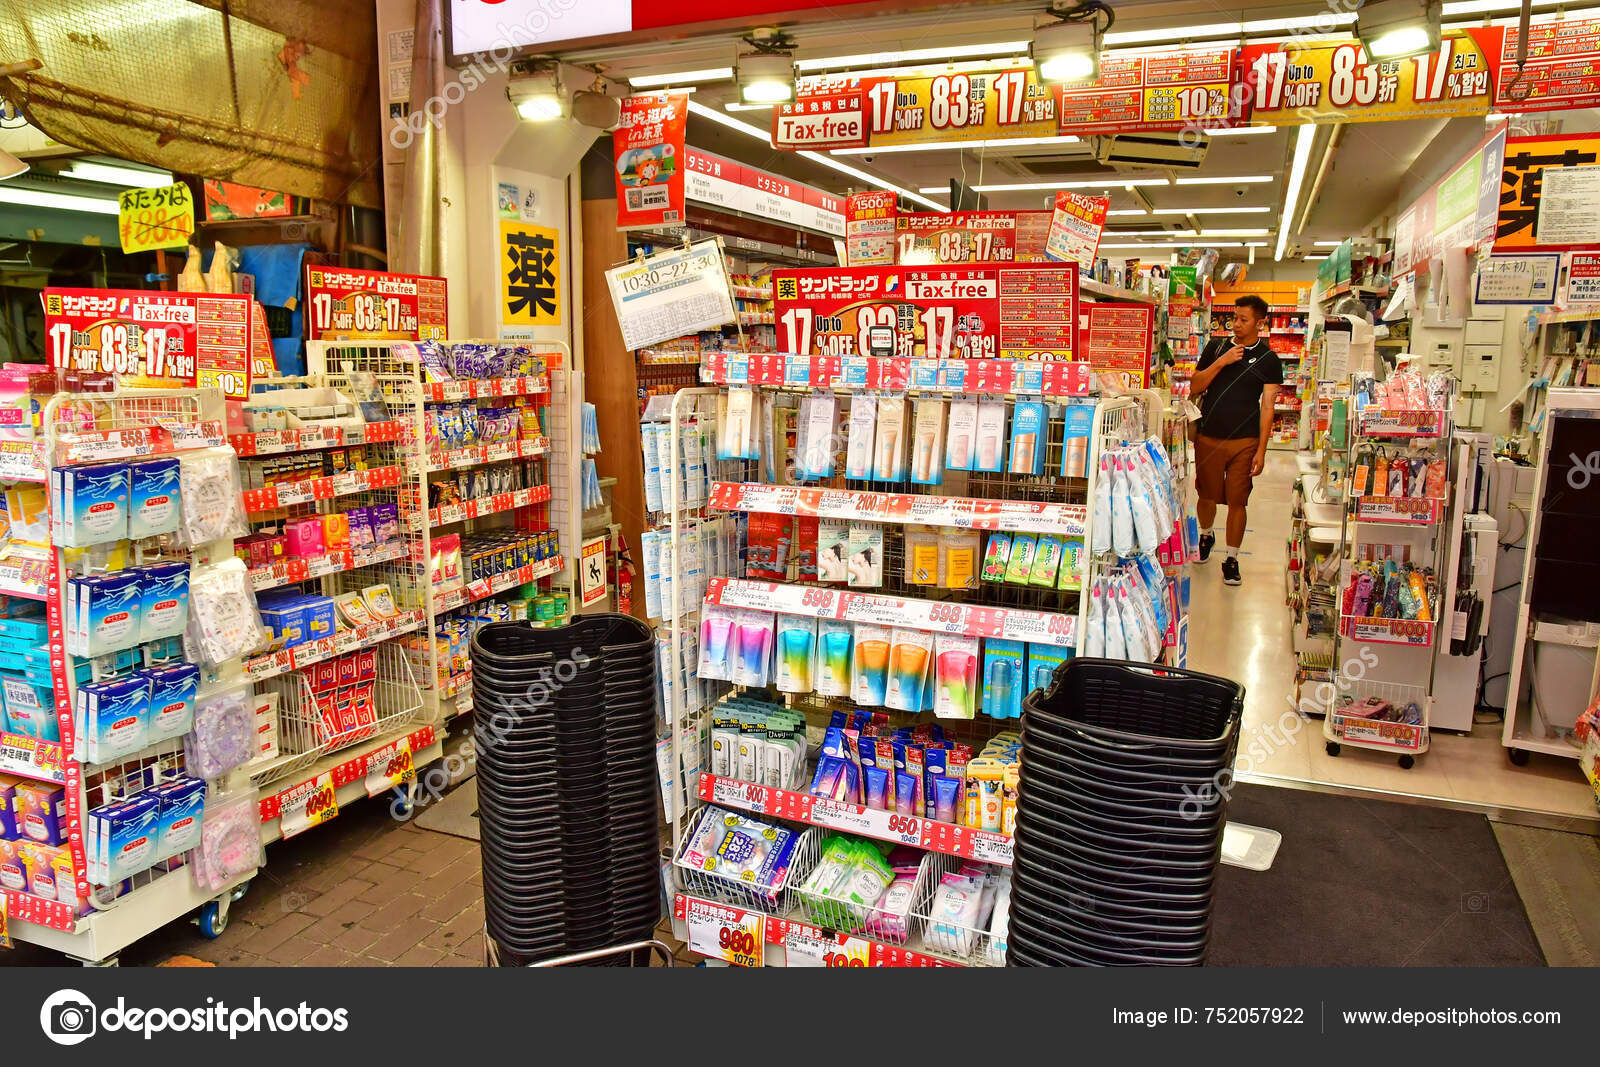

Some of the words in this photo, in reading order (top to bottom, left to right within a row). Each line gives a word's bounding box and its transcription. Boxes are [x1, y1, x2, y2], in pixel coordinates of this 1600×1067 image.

[1454, 54, 1477, 70] 최고
[1253, 52, 1287, 109] 17
[1288, 64, 1302, 81] Up
[1303, 65, 1313, 79] to
[1028, 85, 1045, 98] 최고
[1378, 77, 1399, 102] 折
[1447, 71, 1489, 98] %할인
[897, 94, 908, 108] Up
[909, 92, 918, 106] to
[931, 75, 969, 128] 83
[971, 89, 986, 101] 可享
[996, 70, 1027, 126] 17
[1177, 87, 1208, 117] 10
[1209, 89, 1223, 104] %
[1284, 83, 1321, 107] %OFF
[869, 81, 896, 133] 17
[969, 103, 984, 125] 折
[1024, 99, 1054, 121] %할인
[784, 117, 858, 139] Tax-free
[895, 108, 923, 131] %OFF
[685, 155, 722, 177] タミン剤
[855, 198, 885, 210] 1500
[909, 215, 954, 226] サンドラッグ
[969, 218, 1011, 228] Tax-free
[940, 232, 961, 262] 83
[974, 232, 993, 262] 17
[323, 272, 366, 286] サンドラッグ
[506, 231, 556, 317] 薬
[381, 283, 413, 294] Tax-free
[780, 279, 797, 298] 薬
[800, 275, 879, 293] サンドラッグ
[911, 282, 988, 298] Tax-free
[63, 295, 116, 311] サンドラッグ
[313, 293, 332, 329] 17
[898, 305, 915, 318] 最高
[138, 306, 189, 322] Tax-free
[355, 295, 375, 331] 83
[385, 298, 400, 331] 17
[781, 307, 813, 355] 17
[816, 315, 829, 333] Up
[831, 316, 841, 331] to
[898, 318, 915, 331] 可享
[921, 306, 954, 357] 17
[958, 315, 981, 332] 최고
[49, 323, 71, 369] 17
[73, 332, 83, 346] Up
[83, 332, 91, 346] to
[816, 335, 853, 356] %OFF
[898, 333, 914, 356] 折
[957, 335, 995, 358] %할인
[101, 325, 128, 374] 83
[144, 328, 166, 376] 17
[73, 349, 98, 371] %OFF
[217, 373, 234, 394] 10
[1401, 412, 1436, 427] 2000
[120, 431, 143, 448] 558
[136, 447, 146, 455] 613
[856, 494, 878, 511] 2100
[1394, 499, 1431, 514] 1300
[954, 518, 970, 526] 1490
[802, 588, 835, 608] 598
[816, 607, 830, 616] 657
[929, 603, 962, 623] 598
[945, 623, 959, 632] 657
[1048, 615, 1073, 635] 898
[1389, 621, 1426, 637] 1000
[1055, 636, 1069, 645] 987
[7, 688, 37, 705] 休足時間
[2, 732, 36, 750] お買得品
[1379, 725, 1414, 740] 1500
[384, 751, 409, 778] 850
[401, 770, 413, 782] 935
[280, 781, 315, 803] お買得品
[745, 785, 765, 804] 900
[305, 787, 332, 818] 1090
[751, 803, 763, 812] 990
[815, 798, 858, 814] お買得品
[320, 807, 336, 822] 1199
[888, 814, 919, 836] 950
[901, 834, 916, 844] 1045
[861, 874, 879, 889] Biore
[691, 901, 737, 920] 好評発売中
[719, 926, 754, 956] 980
[734, 953, 755, 967] 1078
